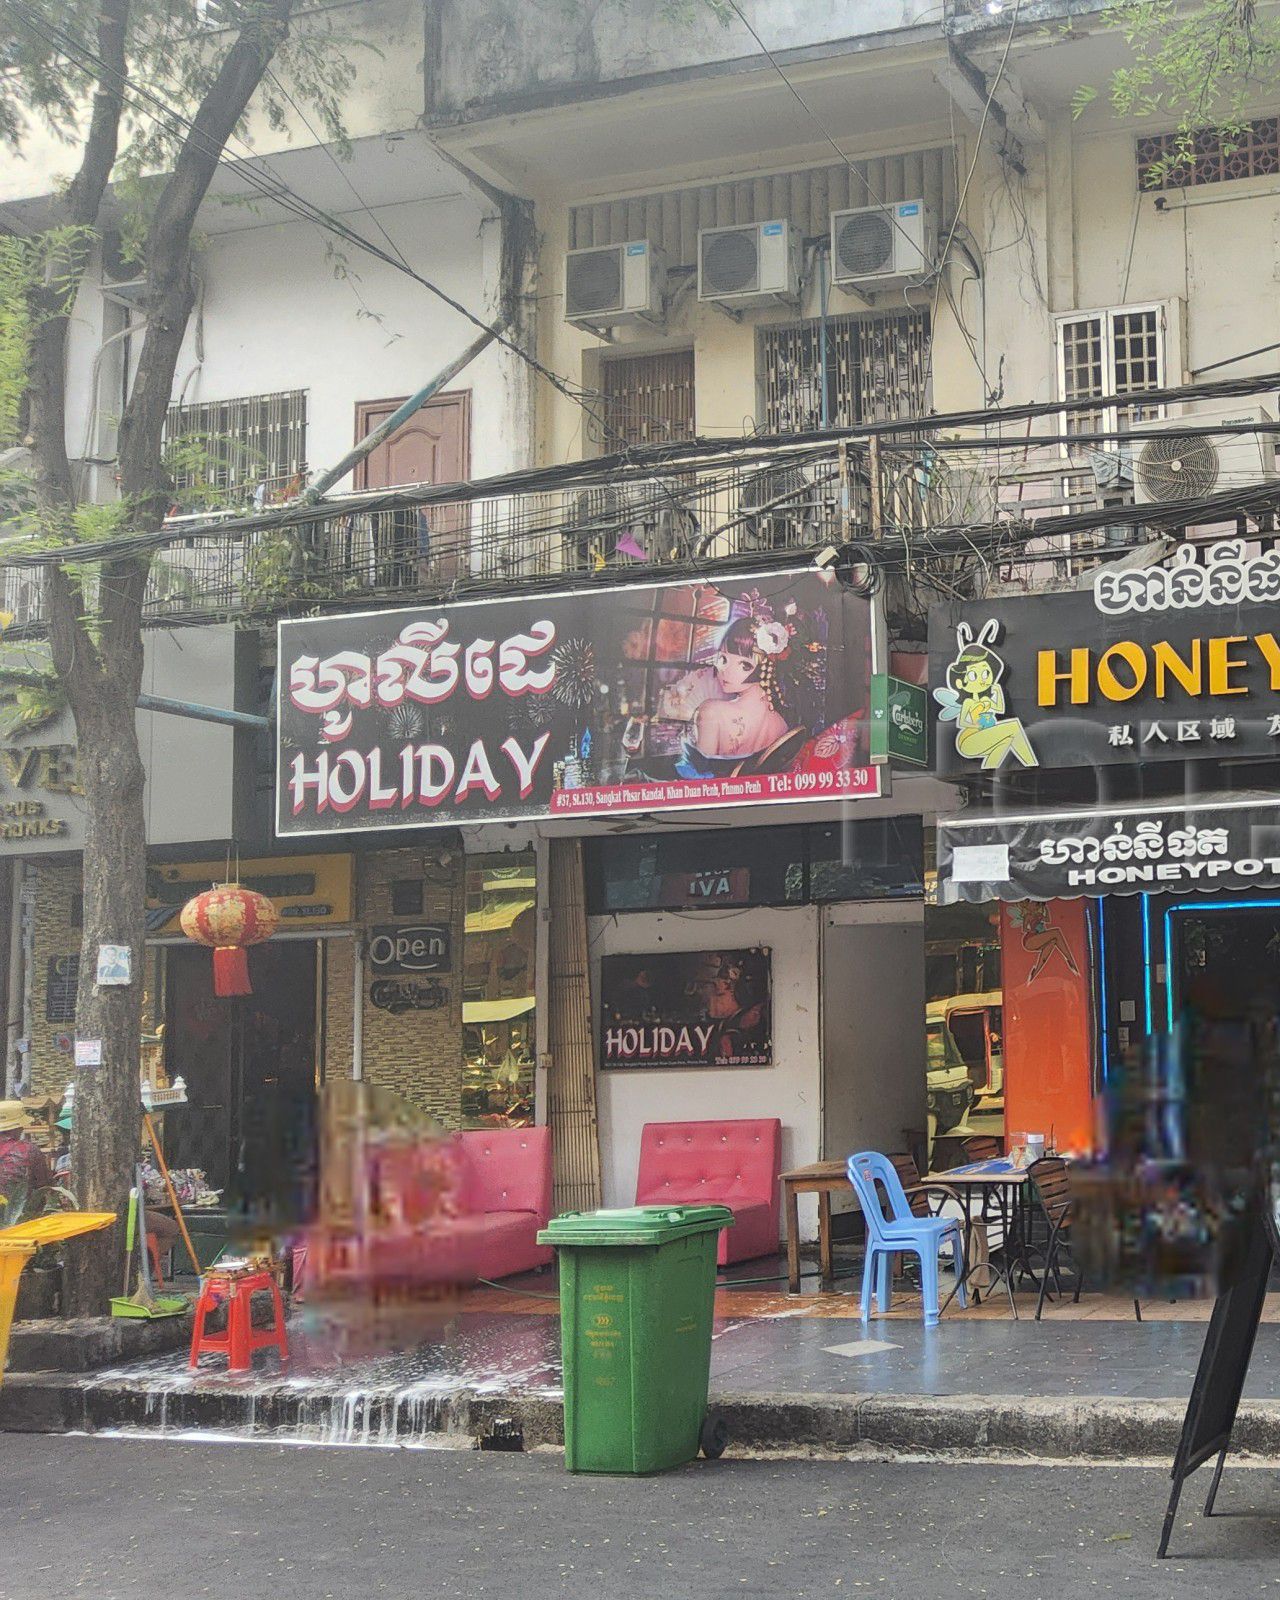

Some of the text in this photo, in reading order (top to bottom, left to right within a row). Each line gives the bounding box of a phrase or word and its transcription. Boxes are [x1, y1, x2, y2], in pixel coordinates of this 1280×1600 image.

[892, 704, 923, 733] Carlsberg
[1107, 717, 1236, 747] 私人区域
[289, 733, 550, 815] HOLIDAY
[596, 790, 621, 807] Sangkat
[623, 789, 640, 803] Phsar
[642, 788, 665, 801] Kandal,
[667, 786, 683, 800] Khan
[703, 783, 720, 798] Penh,
[745, 780, 761, 794] Penh
[768, 775, 791, 793] Tel:
[795, 773, 816, 791] 099
[819, 772, 833, 789] 99
[836, 770, 850, 788] 33
[853, 769, 868, 787] 30
[370, 935, 445, 964] Open
[606, 1024, 714, 1058] HOLIDAY
